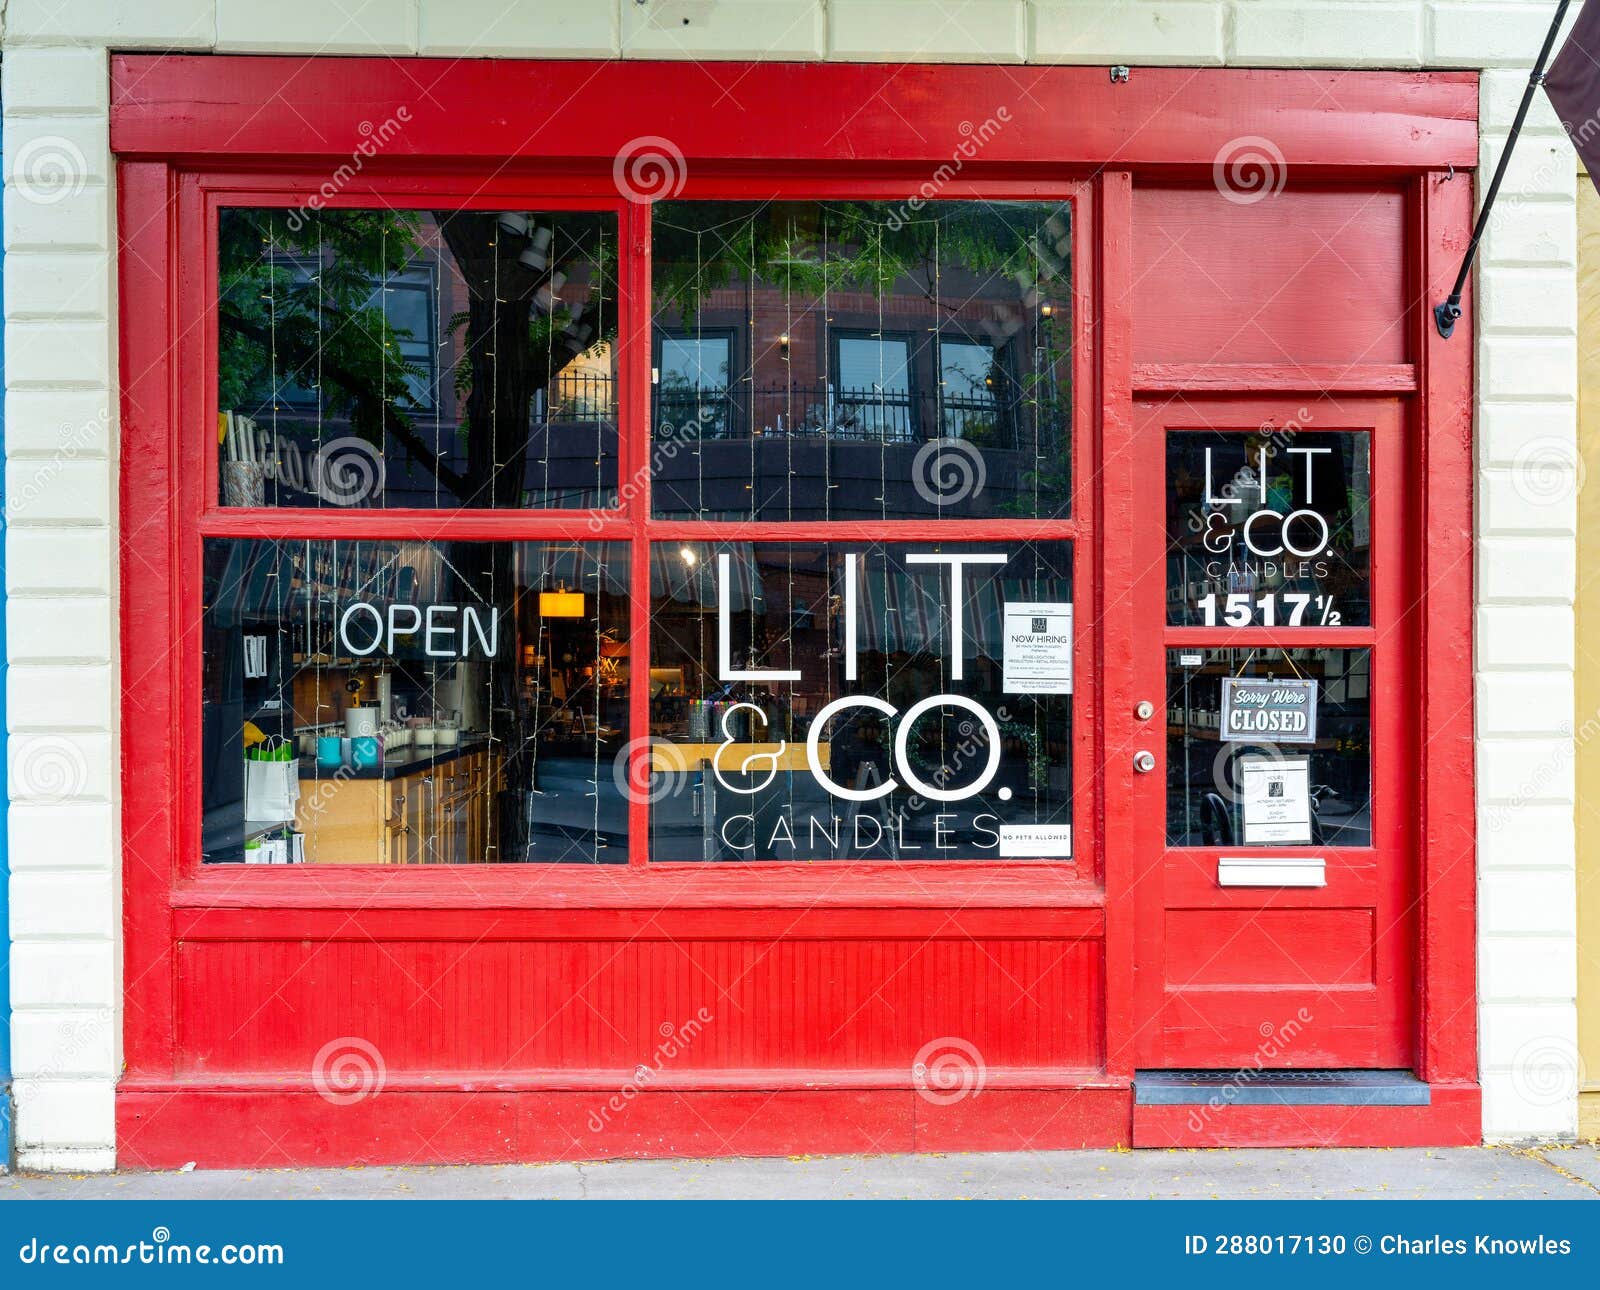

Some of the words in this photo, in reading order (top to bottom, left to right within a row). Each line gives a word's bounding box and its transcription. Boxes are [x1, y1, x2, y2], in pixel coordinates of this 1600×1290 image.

[1205, 447, 1332, 504] LIT
[1203, 512, 1235, 553] &
[1243, 509, 1334, 557] CO.
[1206, 561, 1328, 578] CANDLES
[718, 553, 1008, 681] LIT
[1197, 593, 1311, 626] 1517
[340, 602, 498, 658] OPEN
[1011, 635, 1034, 643] NOW
[1036, 635, 1067, 643] HIRING
[1234, 689, 1270, 708] Sorry
[1230, 709, 1307, 732] CLOSED
[713, 702, 786, 794] &
[806, 694, 1013, 802] CO.
[721, 814, 1001, 849] CANDLES
